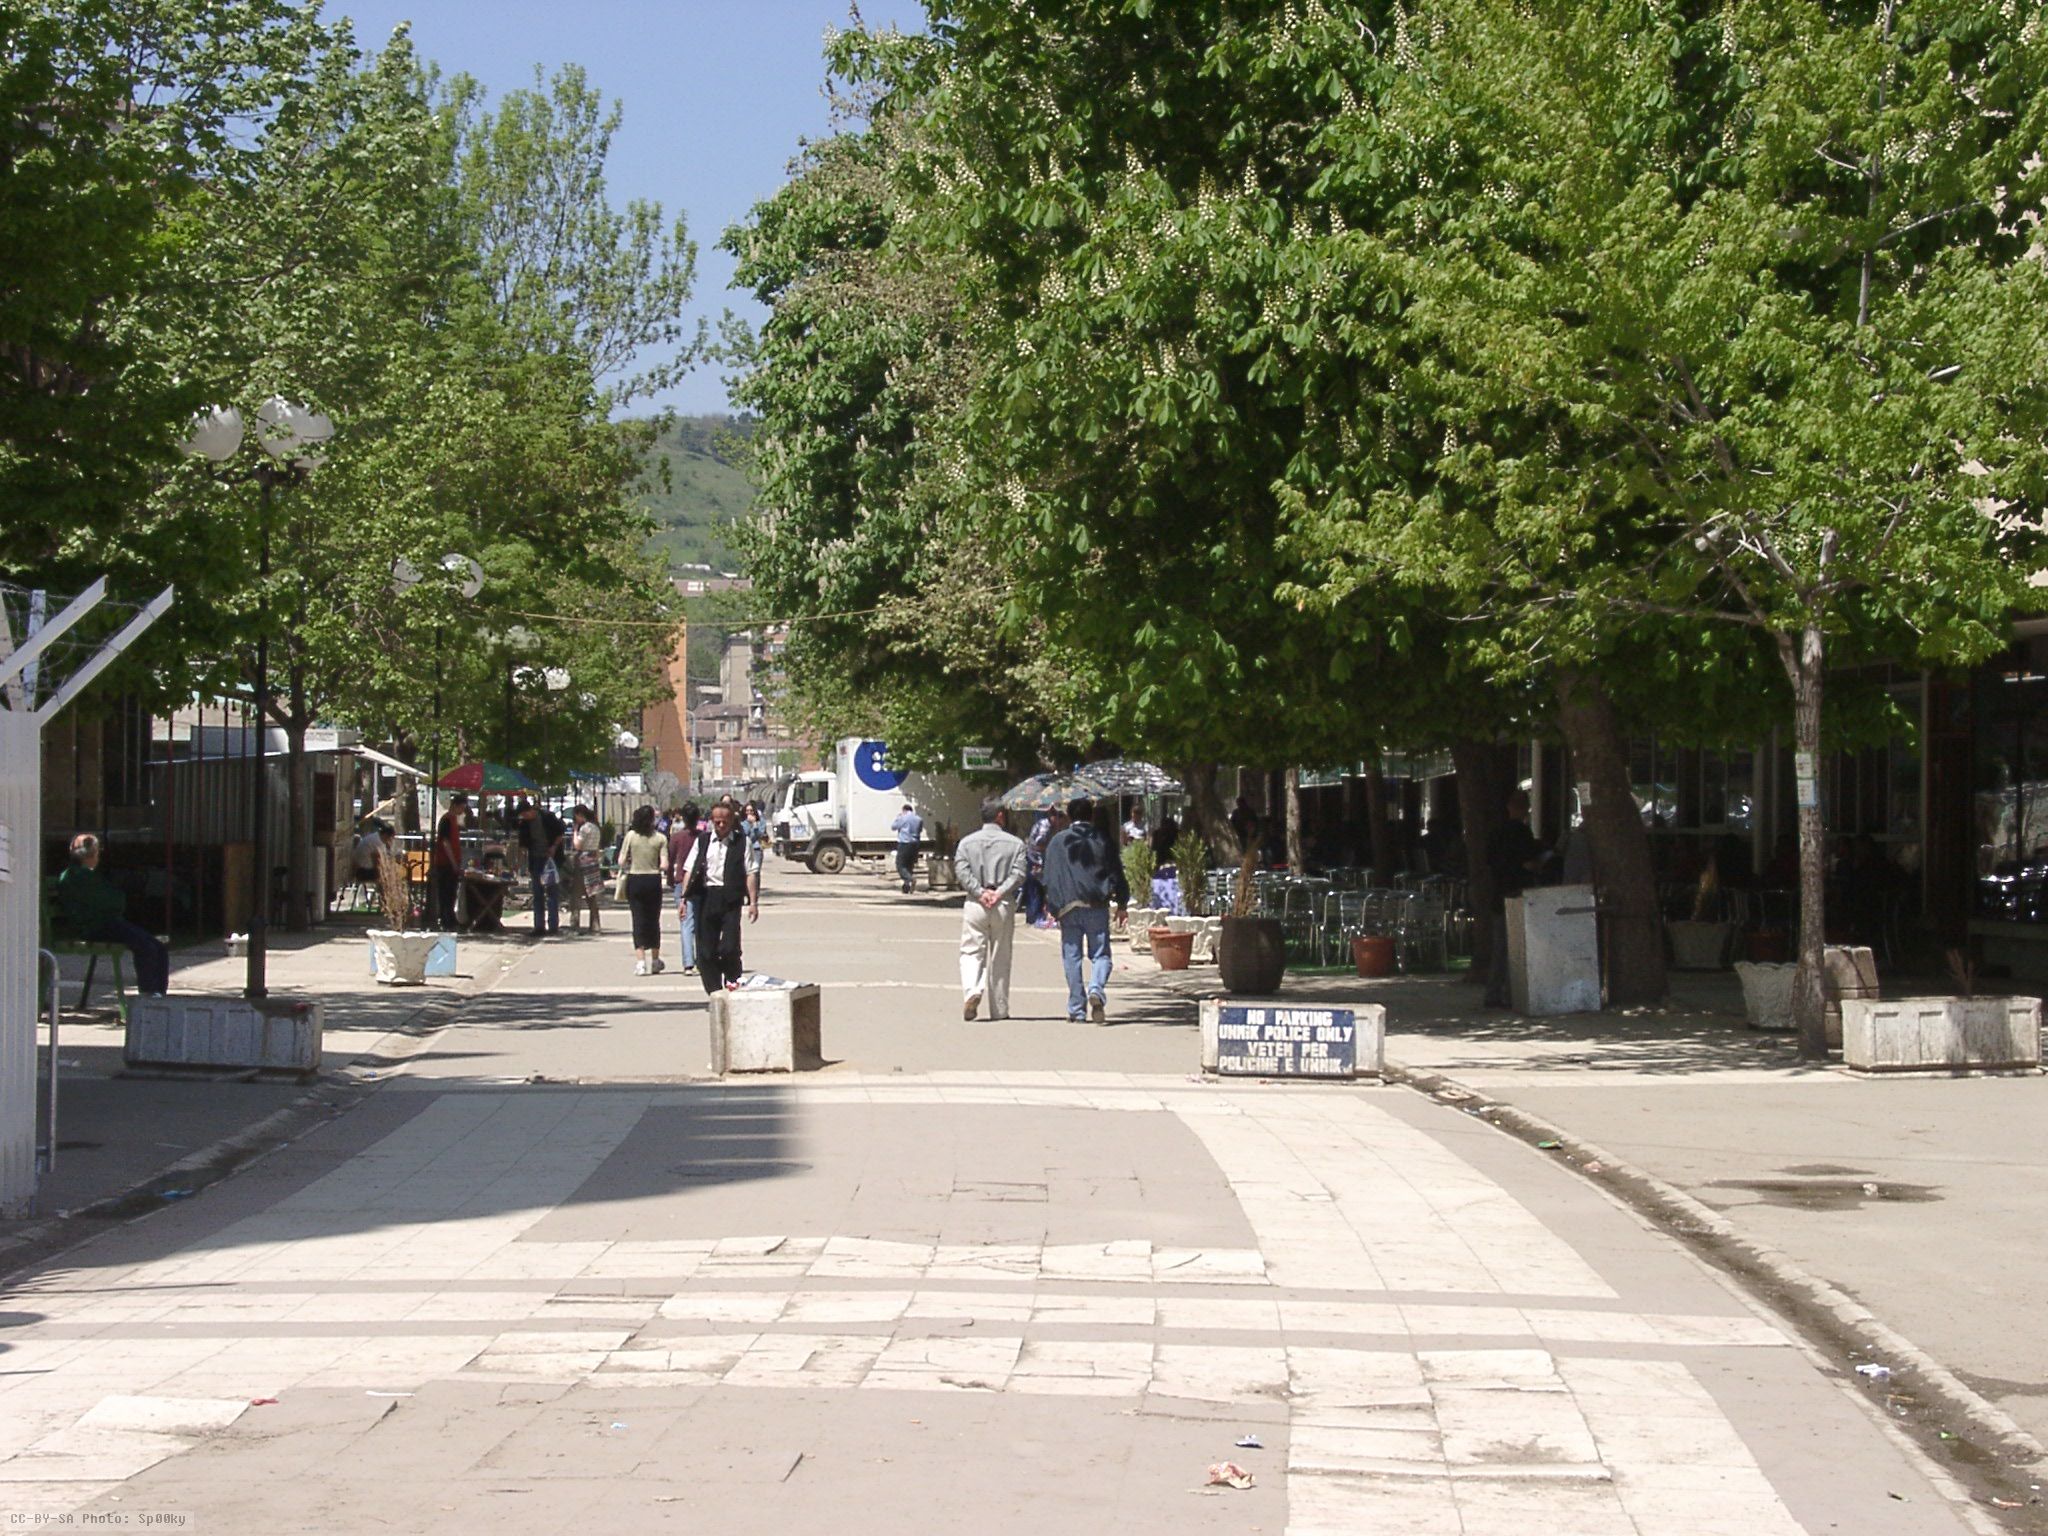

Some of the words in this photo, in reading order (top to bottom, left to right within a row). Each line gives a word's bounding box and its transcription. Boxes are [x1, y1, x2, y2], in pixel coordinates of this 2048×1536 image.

[1247, 1009, 1265, 1025] NO
[1275, 1010, 1333, 1026] PARKING
[1264, 1025, 1310, 1041] POLICE
[1316, 1026, 1353, 1042] ONLY
